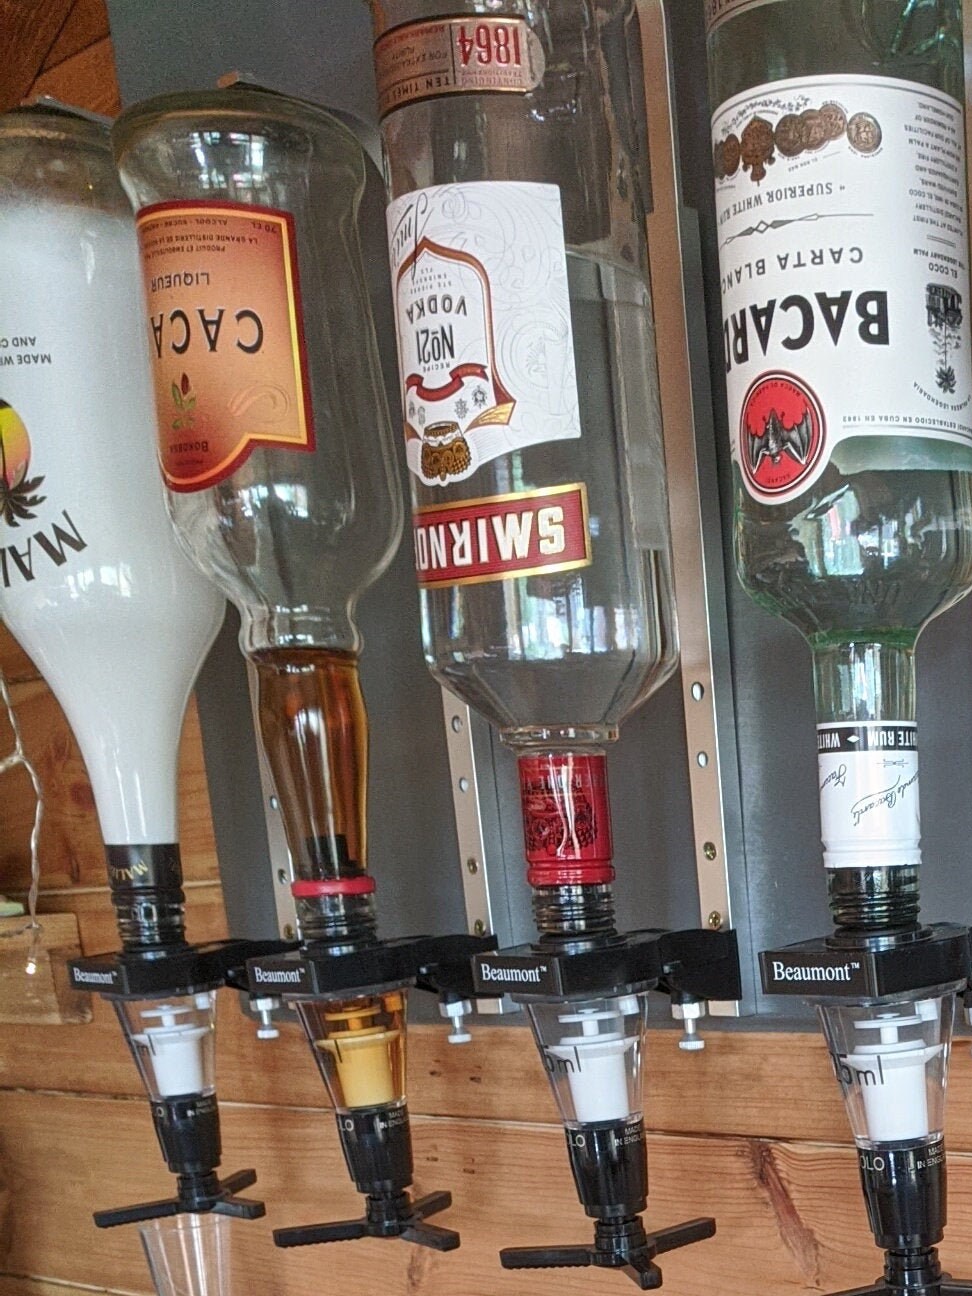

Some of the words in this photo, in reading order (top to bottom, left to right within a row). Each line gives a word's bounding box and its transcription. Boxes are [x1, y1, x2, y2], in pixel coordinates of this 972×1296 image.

[457, 23, 521, 67] 1864
[765, 182, 833, 203] SUPERIOR
[732, 194, 763, 215] WHITE
[776, 245, 864, 270] CARTA
[928, 262, 949, 275] COCO
[151, 270, 210, 293] LIQUEUR
[405, 293, 468, 319] VODKA
[11, 336, 36, 347] AND
[16, 353, 51, 365] MADE
[878, 415, 900, 423] CUBA
[867, 730, 895, 747] RUM
